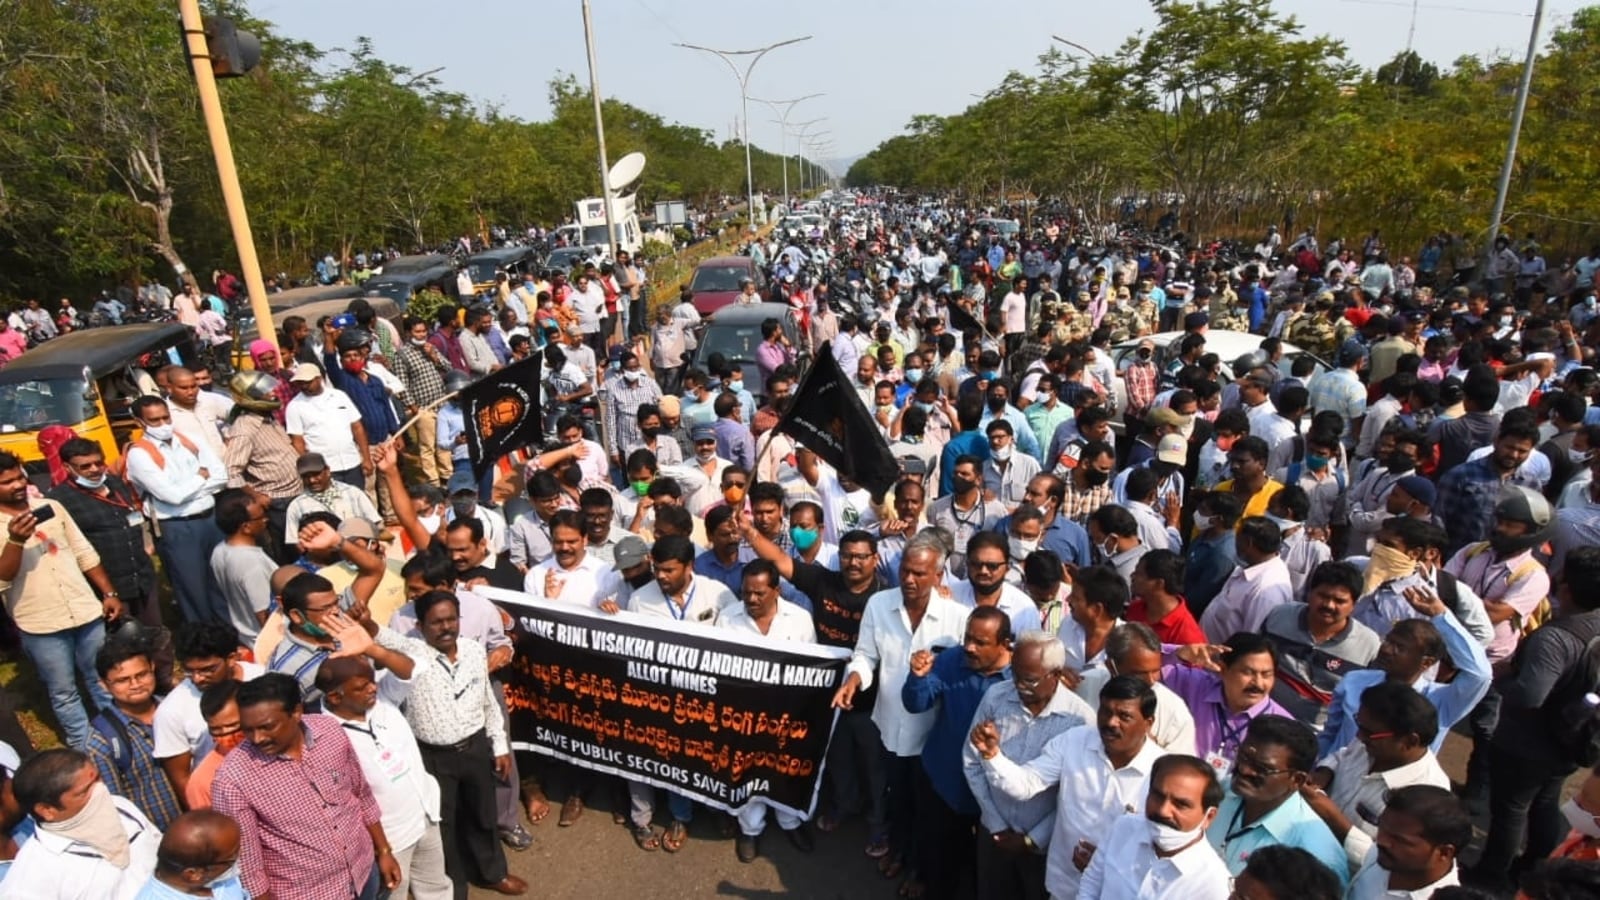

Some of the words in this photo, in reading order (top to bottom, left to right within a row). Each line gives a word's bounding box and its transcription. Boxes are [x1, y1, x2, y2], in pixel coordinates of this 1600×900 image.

[520, 616, 554, 640] SAVE
[557, 623, 588, 648] RINL
[591, 629, 654, 661] VISAKHA
[657, 641, 699, 669] UKKU
[700, 650, 780, 685] ANDHRULA
[783, 664, 836, 688] HAKKU
[627, 661, 669, 684] ALLOT
[671, 669, 717, 695] MINES
[536, 726, 568, 749] SAVE
[571, 739, 623, 764] PUBLIC
[627, 754, 688, 783] SECTORS
[693, 773, 727, 798] SAVE
